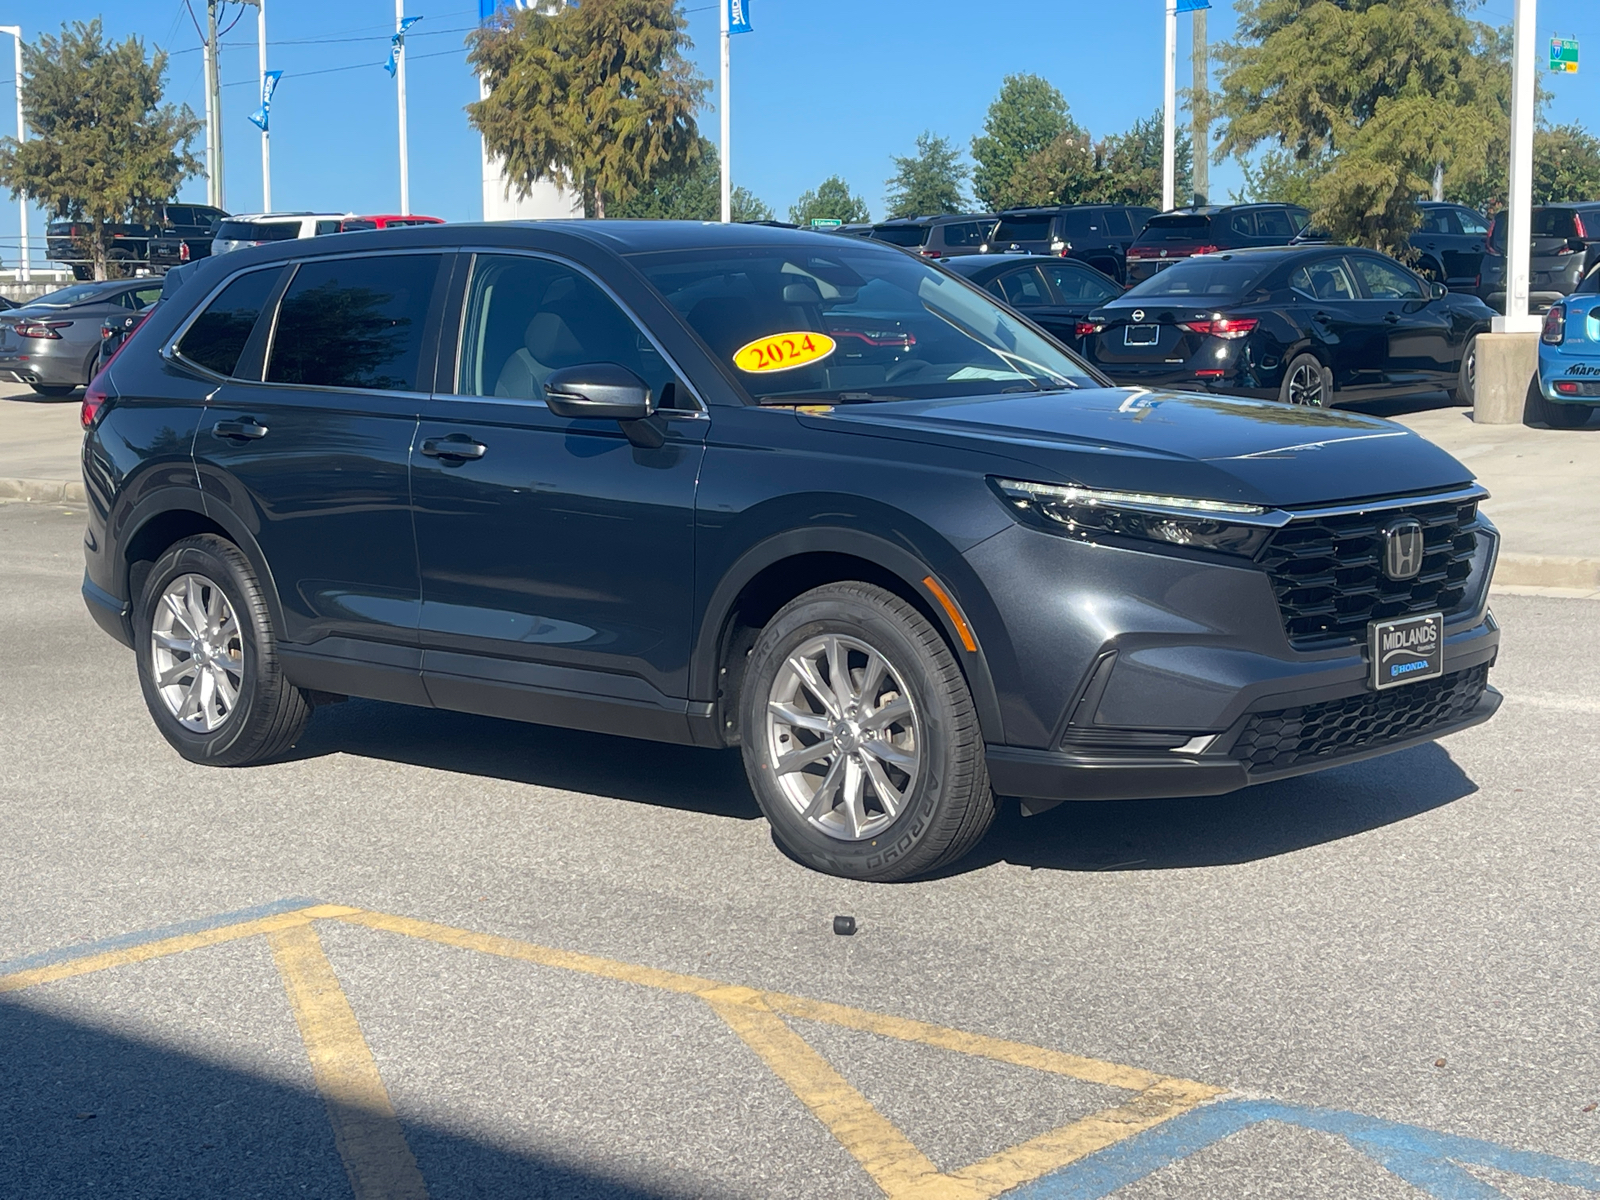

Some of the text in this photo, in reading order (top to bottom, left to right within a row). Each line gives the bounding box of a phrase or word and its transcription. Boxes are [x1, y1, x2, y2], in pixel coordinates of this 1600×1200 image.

[750, 334, 816, 369] 2024
[1383, 624, 1437, 651] MIDLANDS
[1399, 660, 1429, 673] HONDA
